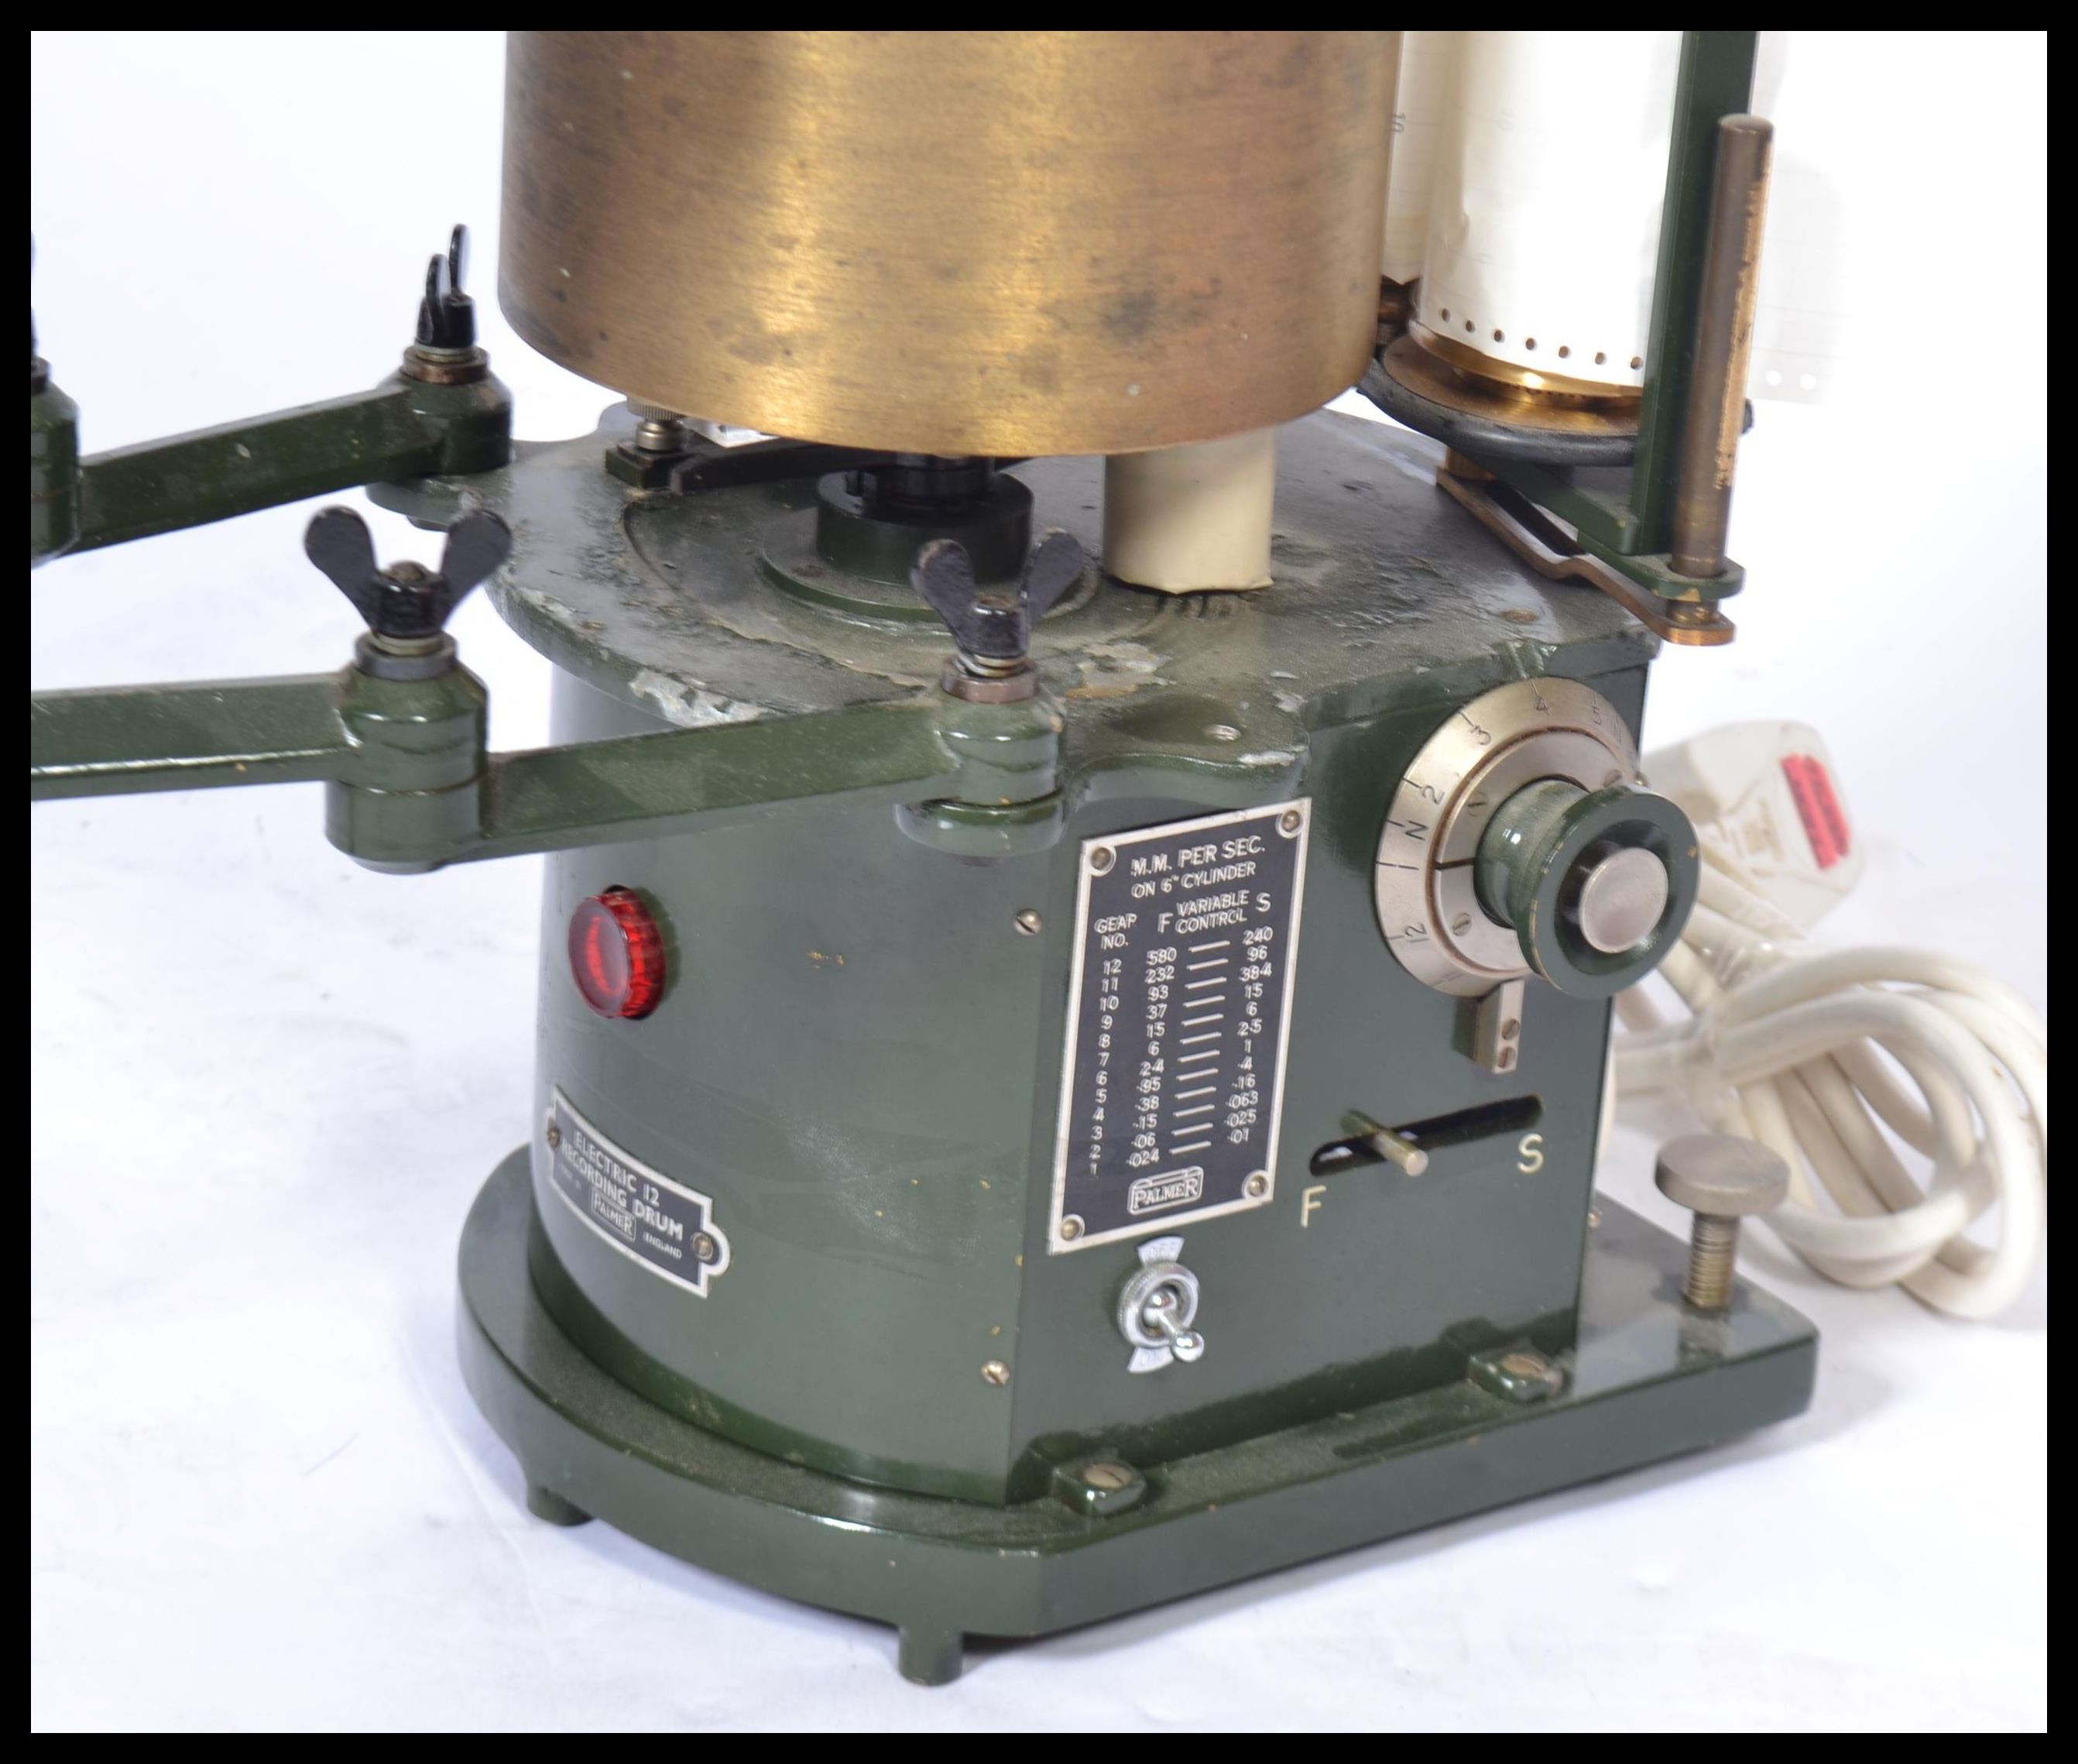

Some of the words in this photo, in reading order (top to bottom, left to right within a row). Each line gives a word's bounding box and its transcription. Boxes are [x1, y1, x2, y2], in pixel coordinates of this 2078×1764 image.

[1470, 726, 1491, 746] 3
[1422, 784, 1445, 805] 2
[1130, 853, 1172, 877] M.M.
[1178, 844, 1217, 868] PER
[1221, 835, 1266, 859] SEC.
[1131, 880, 1156, 898] ON
[1181, 861, 1256, 888] CYLINDER
[1176, 890, 1250, 917] VARIABLE
[1255, 892, 1271, 912] S
[1157, 912, 1174, 933] F
[1175, 908, 1247, 934] CONTROL
[1101, 932, 1129, 950] NO.
[1103, 959, 1122, 975] 12
[1146, 947, 1178, 966] 580
[1243, 925, 1274, 945] 240
[1102, 977, 1118, 993] 11
[1145, 966, 1175, 985] 232
[1247, 945, 1268, 962] 96
[1100, 995, 1120, 1012] 10
[1147, 985, 1169, 1002] 93
[1101, 1014, 1113, 1030] 9
[1146, 1004, 1168, 1021] 37
[1245, 982, 1264, 999] 15
[1098, 1033, 1110, 1048] 8
[1146, 1021, 1165, 1038] 15
[1246, 1000, 1257, 1016] 6
[1096, 1070, 1107, 1086] 6
[1244, 1038, 1252, 1053] 1
[1098, 1051, 1110, 1067] 7
[1148, 1040, 1160, 1056] 6
[1095, 1089, 1107, 1104] 5
[1093, 1107, 1105, 1122] 4
[1092, 1126, 1103, 1141] 3
[1089, 1144, 1101, 1160] 2
[1518, 1133, 1544, 1174] S
[574, 1131, 638, 1193] ELECTRIC
[643, 1183, 660, 1207] 12
[1090, 1162, 1098, 1176] 1
[561, 1138, 627, 1208] RECORDING
[632, 1199, 684, 1241] DRUM
[1133, 1177, 1198, 1210] PALMER
[593, 1192, 633, 1237] PALMER
[1301, 1185, 1326, 1227] F
